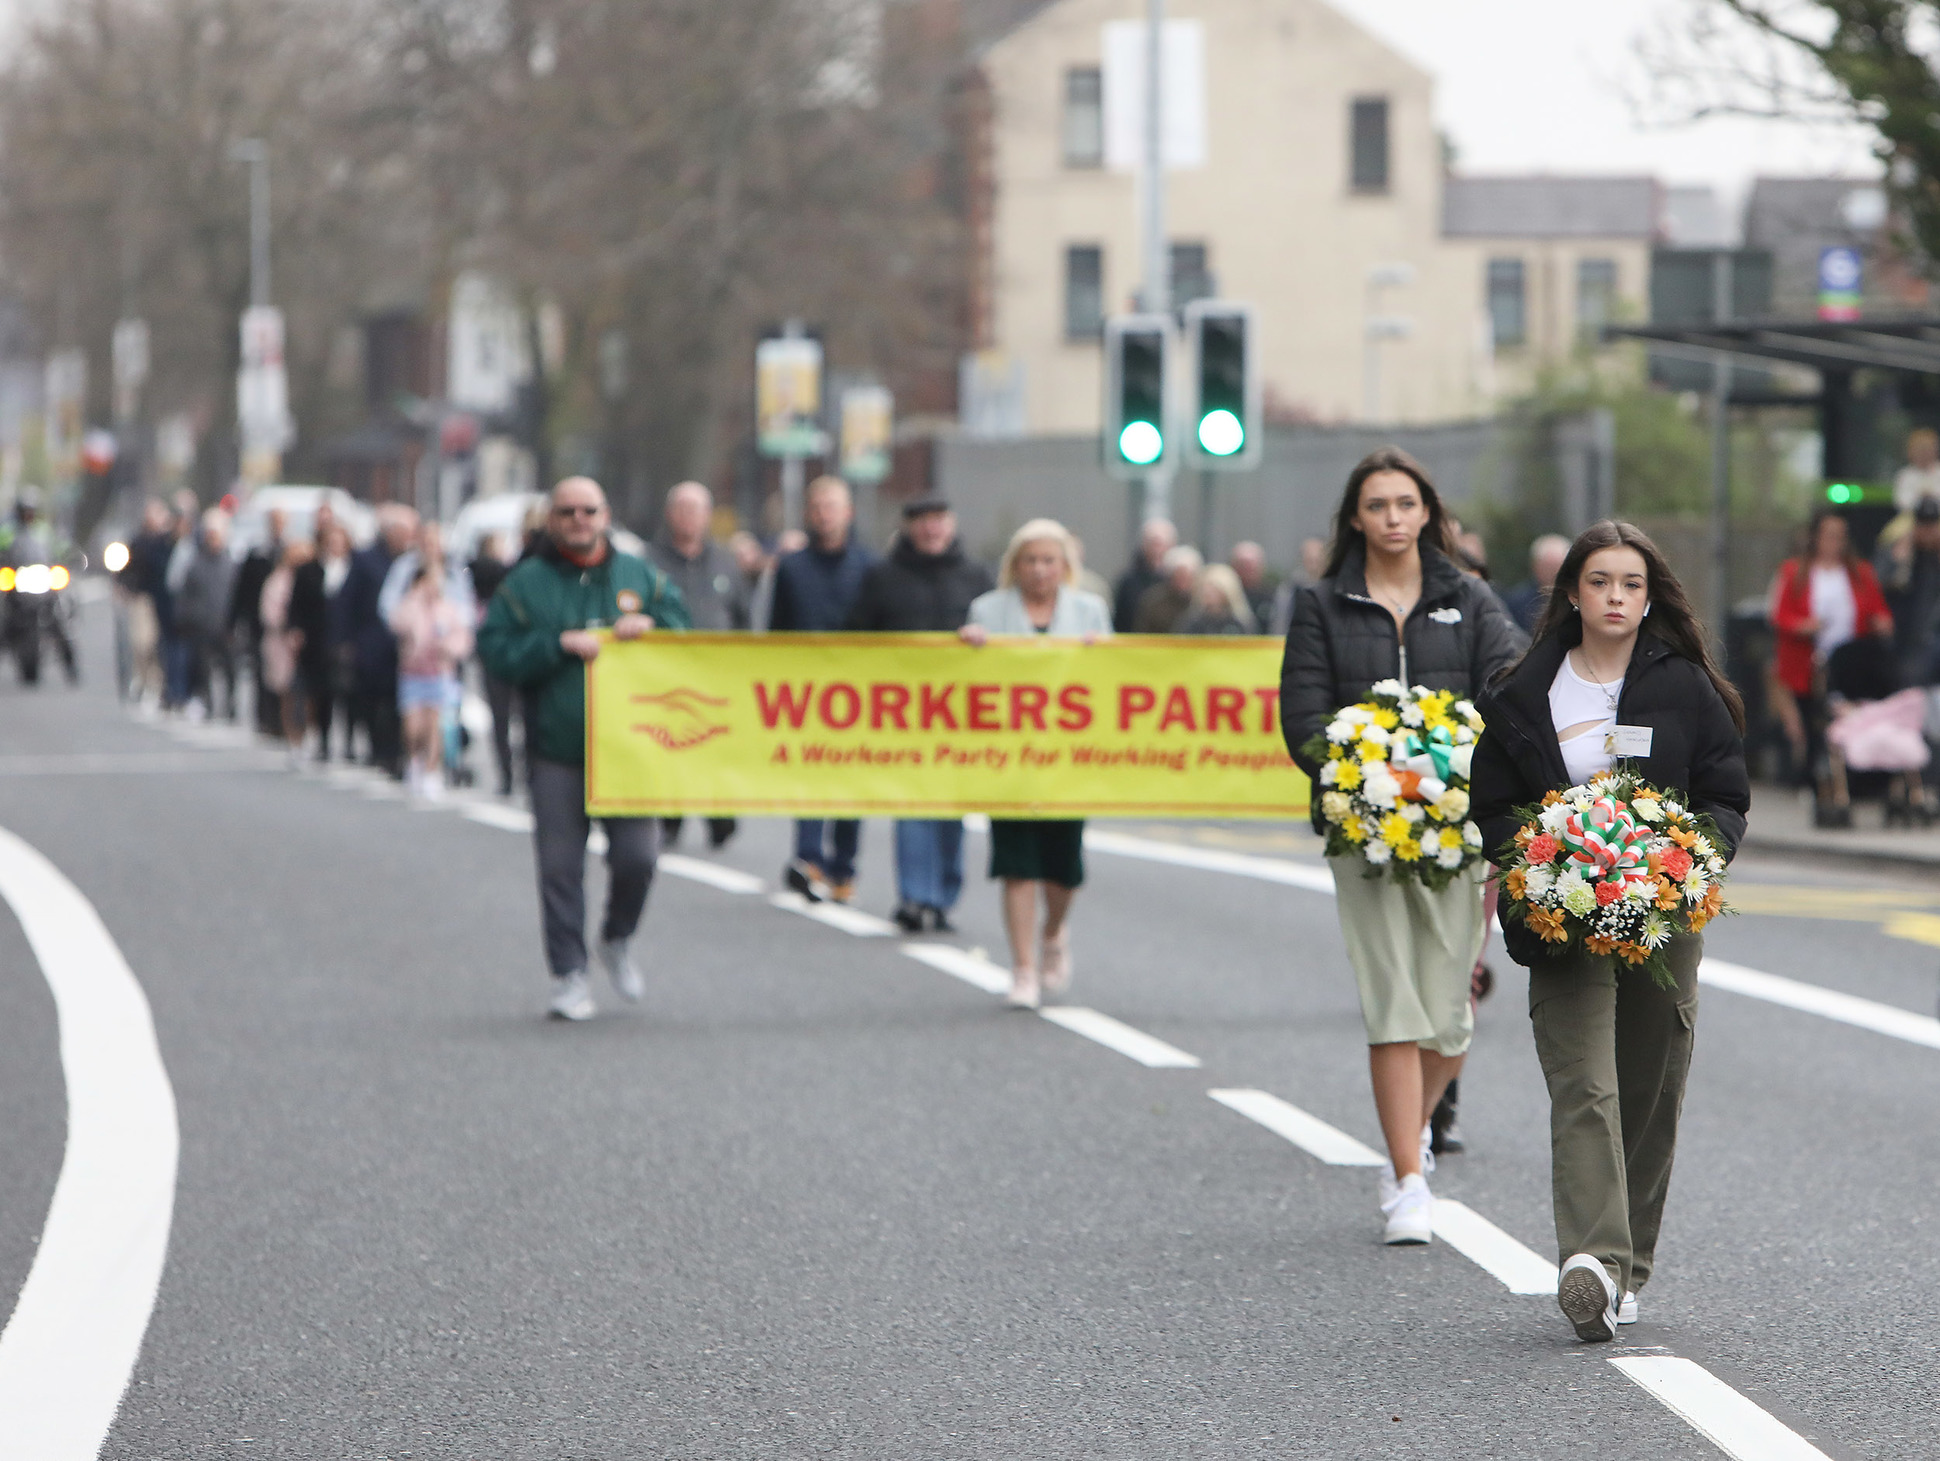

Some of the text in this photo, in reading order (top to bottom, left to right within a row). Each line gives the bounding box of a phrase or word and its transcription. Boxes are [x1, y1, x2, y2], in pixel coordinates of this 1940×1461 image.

[753, 680, 1282, 734] WORKERS PART
[771, 744, 790, 763] A
[801, 744, 923, 765] Workers
[934, 744, 1008, 768] Party
[1021, 744, 1059, 764] for
[1070, 745, 1188, 771] Working
